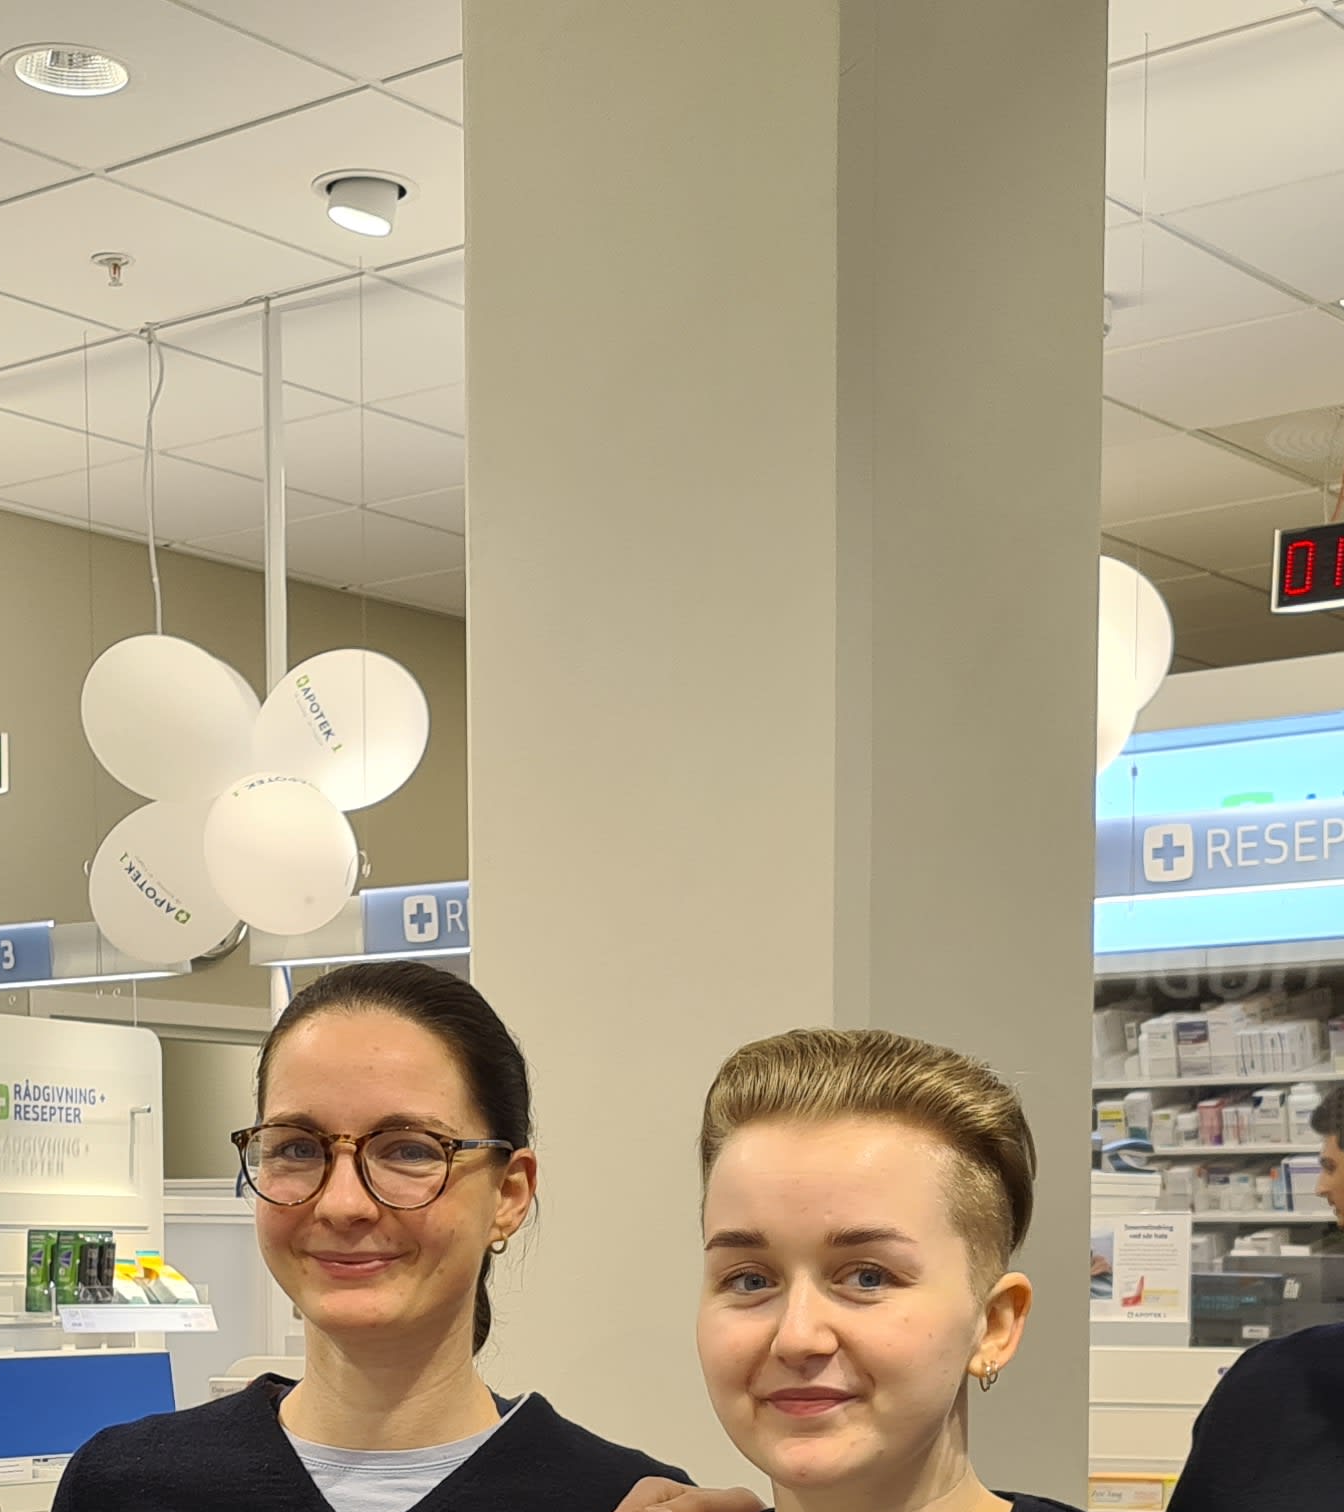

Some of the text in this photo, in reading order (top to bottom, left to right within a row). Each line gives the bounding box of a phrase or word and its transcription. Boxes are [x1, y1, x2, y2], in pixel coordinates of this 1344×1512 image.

[299, 687, 336, 742] APOTEK
[124, 861, 176, 915] APOTEK
[0, 939, 16, 970] 3
[13, 1079, 96, 1105] RÅDGIVNING
[13, 1104, 82, 1124] RESEPTER
